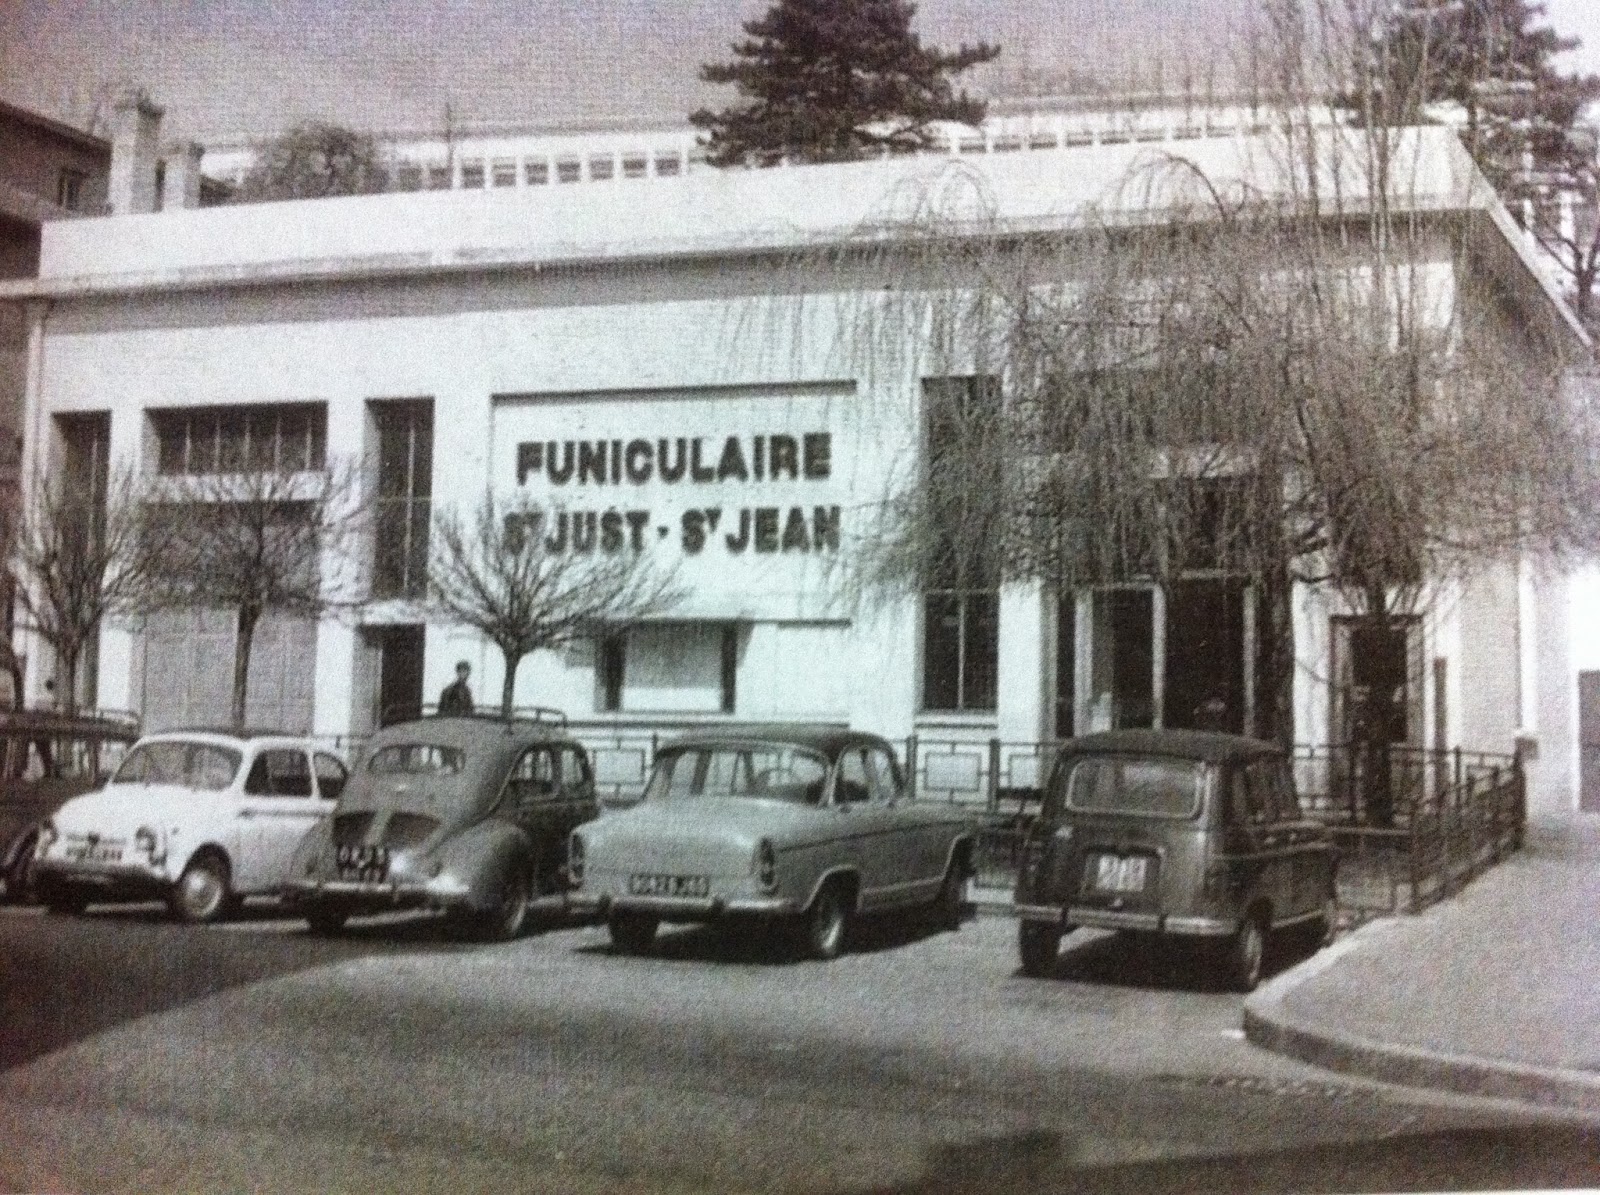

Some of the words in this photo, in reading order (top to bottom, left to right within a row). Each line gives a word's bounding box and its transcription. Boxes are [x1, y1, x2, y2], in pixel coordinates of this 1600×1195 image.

[516, 431, 832, 486] FUNICULAIRE
[545, 507, 650, 555] JUST
[725, 505, 841, 555] JEAN
